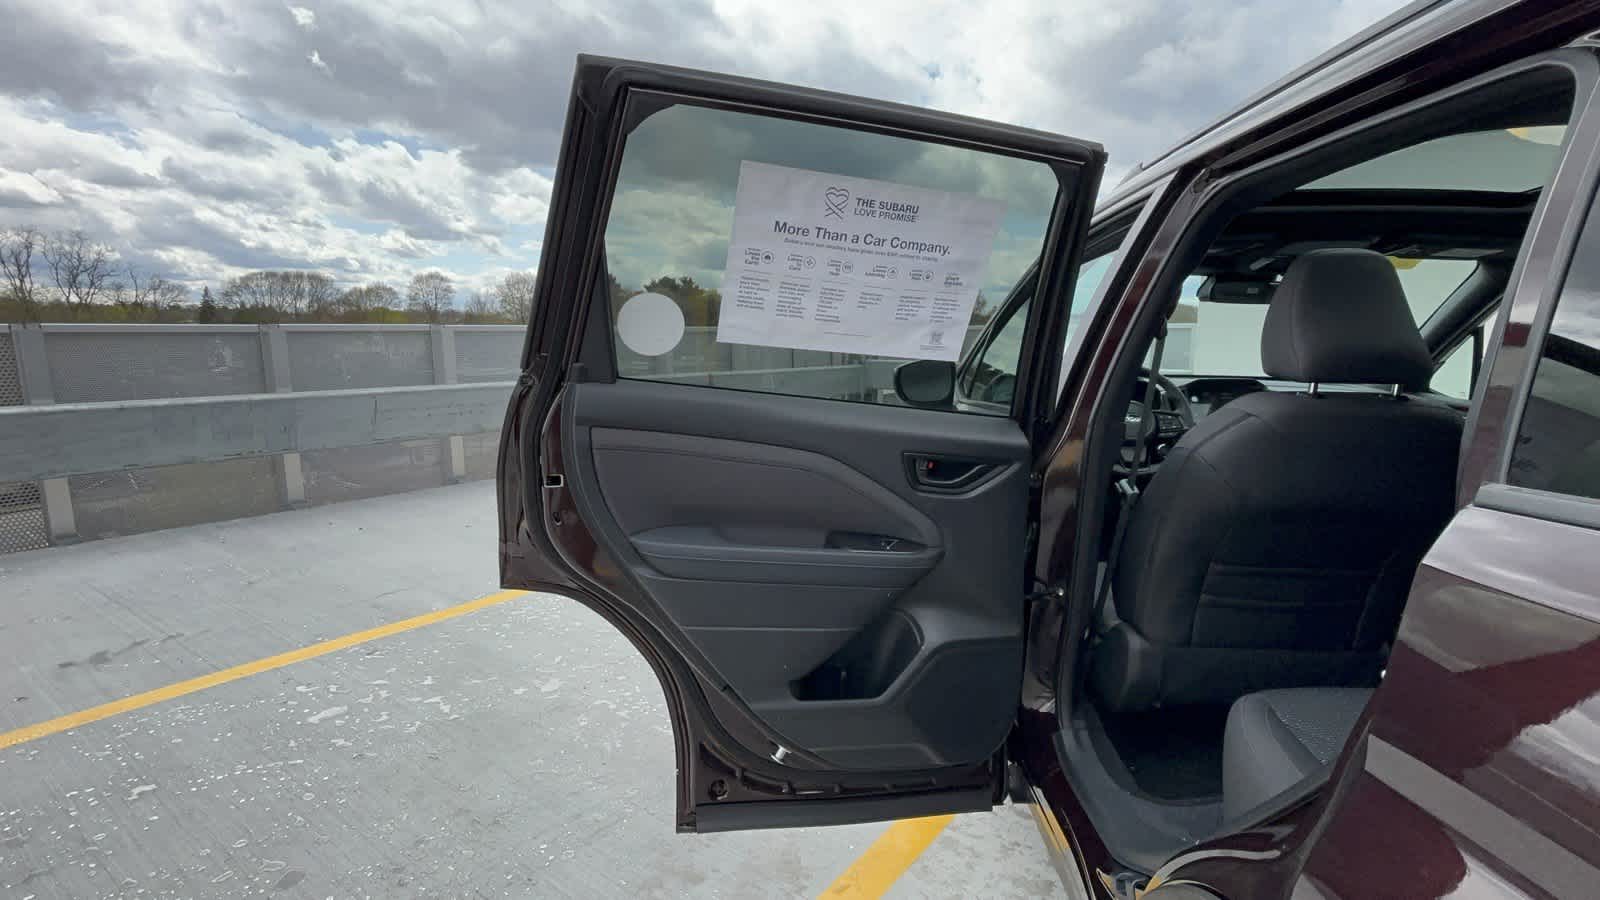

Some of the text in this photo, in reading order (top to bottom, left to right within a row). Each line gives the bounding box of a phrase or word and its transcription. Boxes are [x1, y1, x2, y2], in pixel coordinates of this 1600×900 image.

[854, 208, 876, 218] LOVE
[856, 198, 920, 214] THE SUBARU
[773, 220, 810, 237] More
[815, 226, 848, 242] Than
[851, 233, 860, 244] a
[863, 233, 888, 247] Car
[890, 237, 951, 256] Company.
